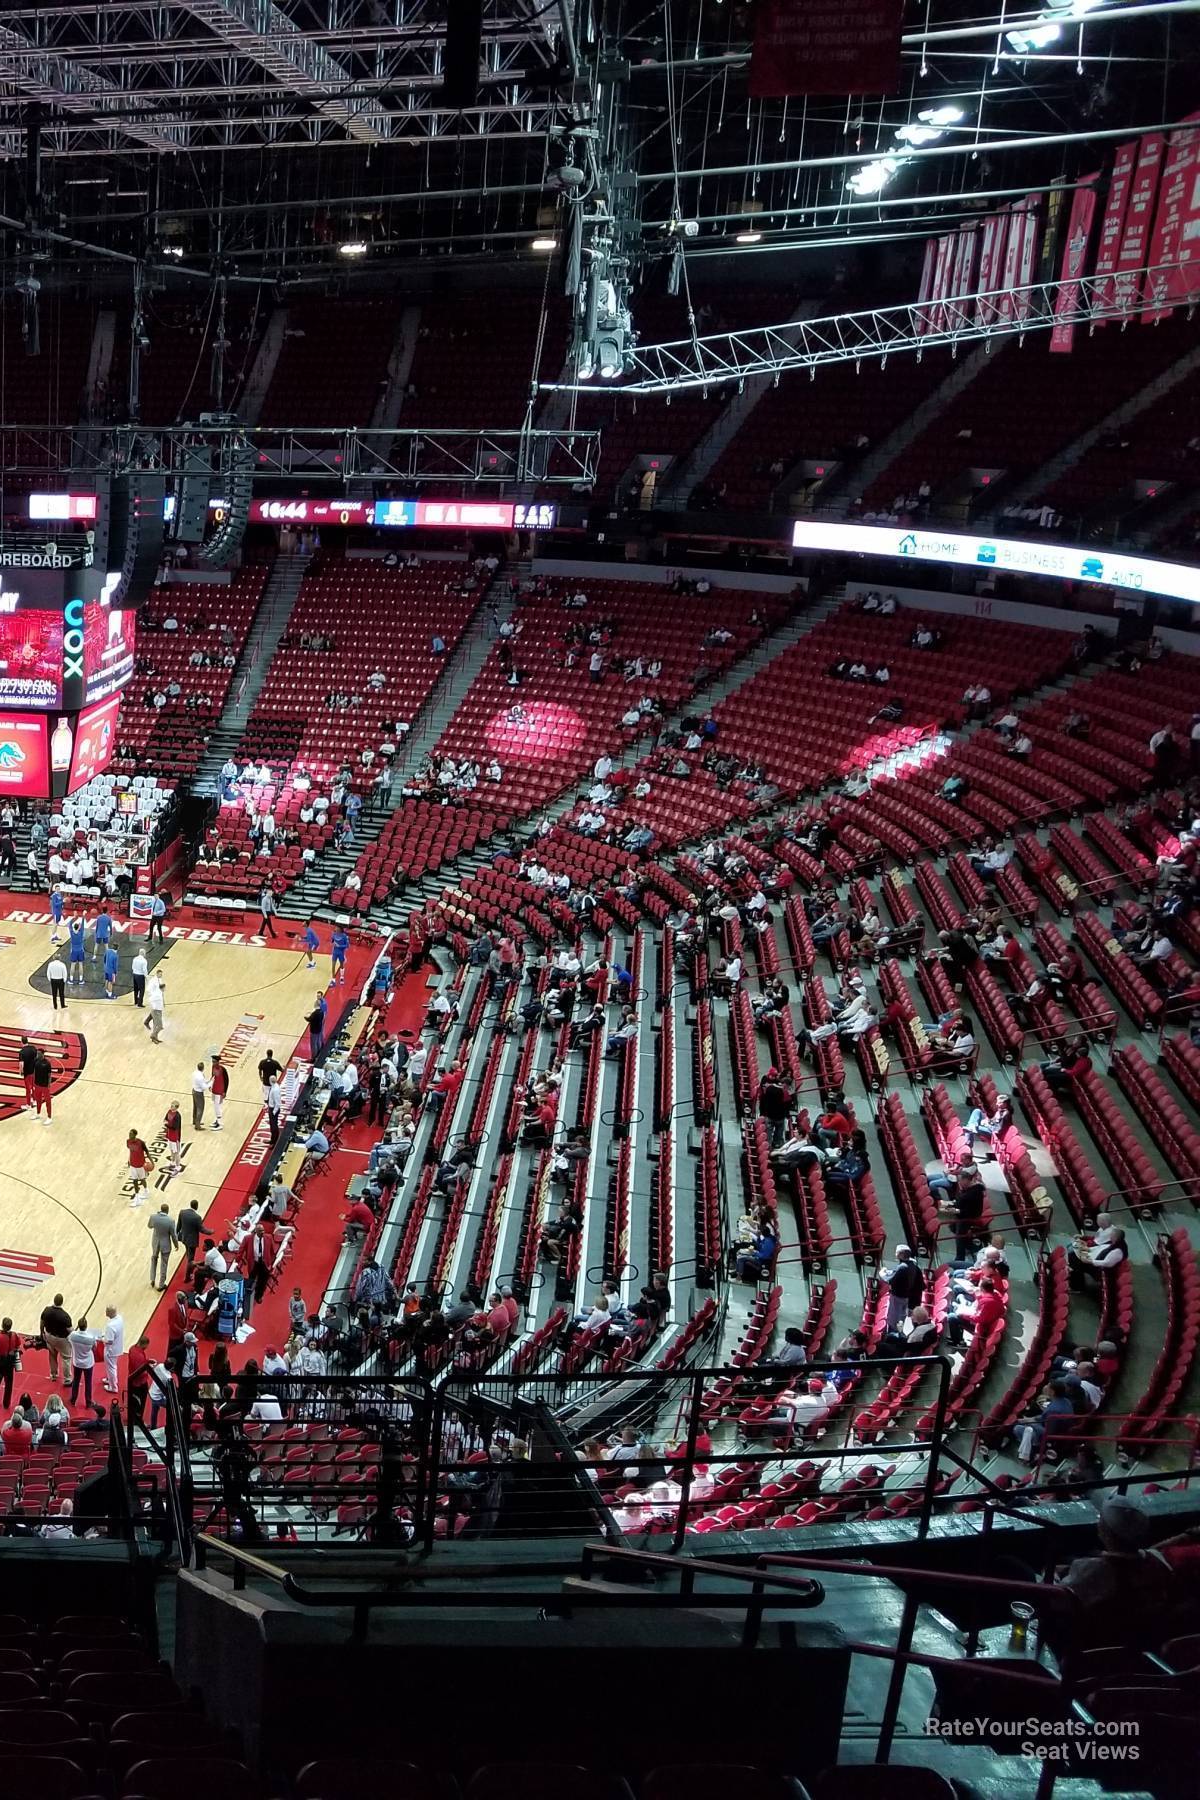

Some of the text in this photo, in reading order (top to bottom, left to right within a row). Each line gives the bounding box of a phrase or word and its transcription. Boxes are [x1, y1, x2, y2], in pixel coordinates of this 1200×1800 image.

[340, 511, 349, 523] 0
[921, 542, 960, 555] HOME
[1003, 549, 1065, 570] BUSINESS
[1111, 571, 1143, 588] AUTO
[64, 599, 84, 679] COX
